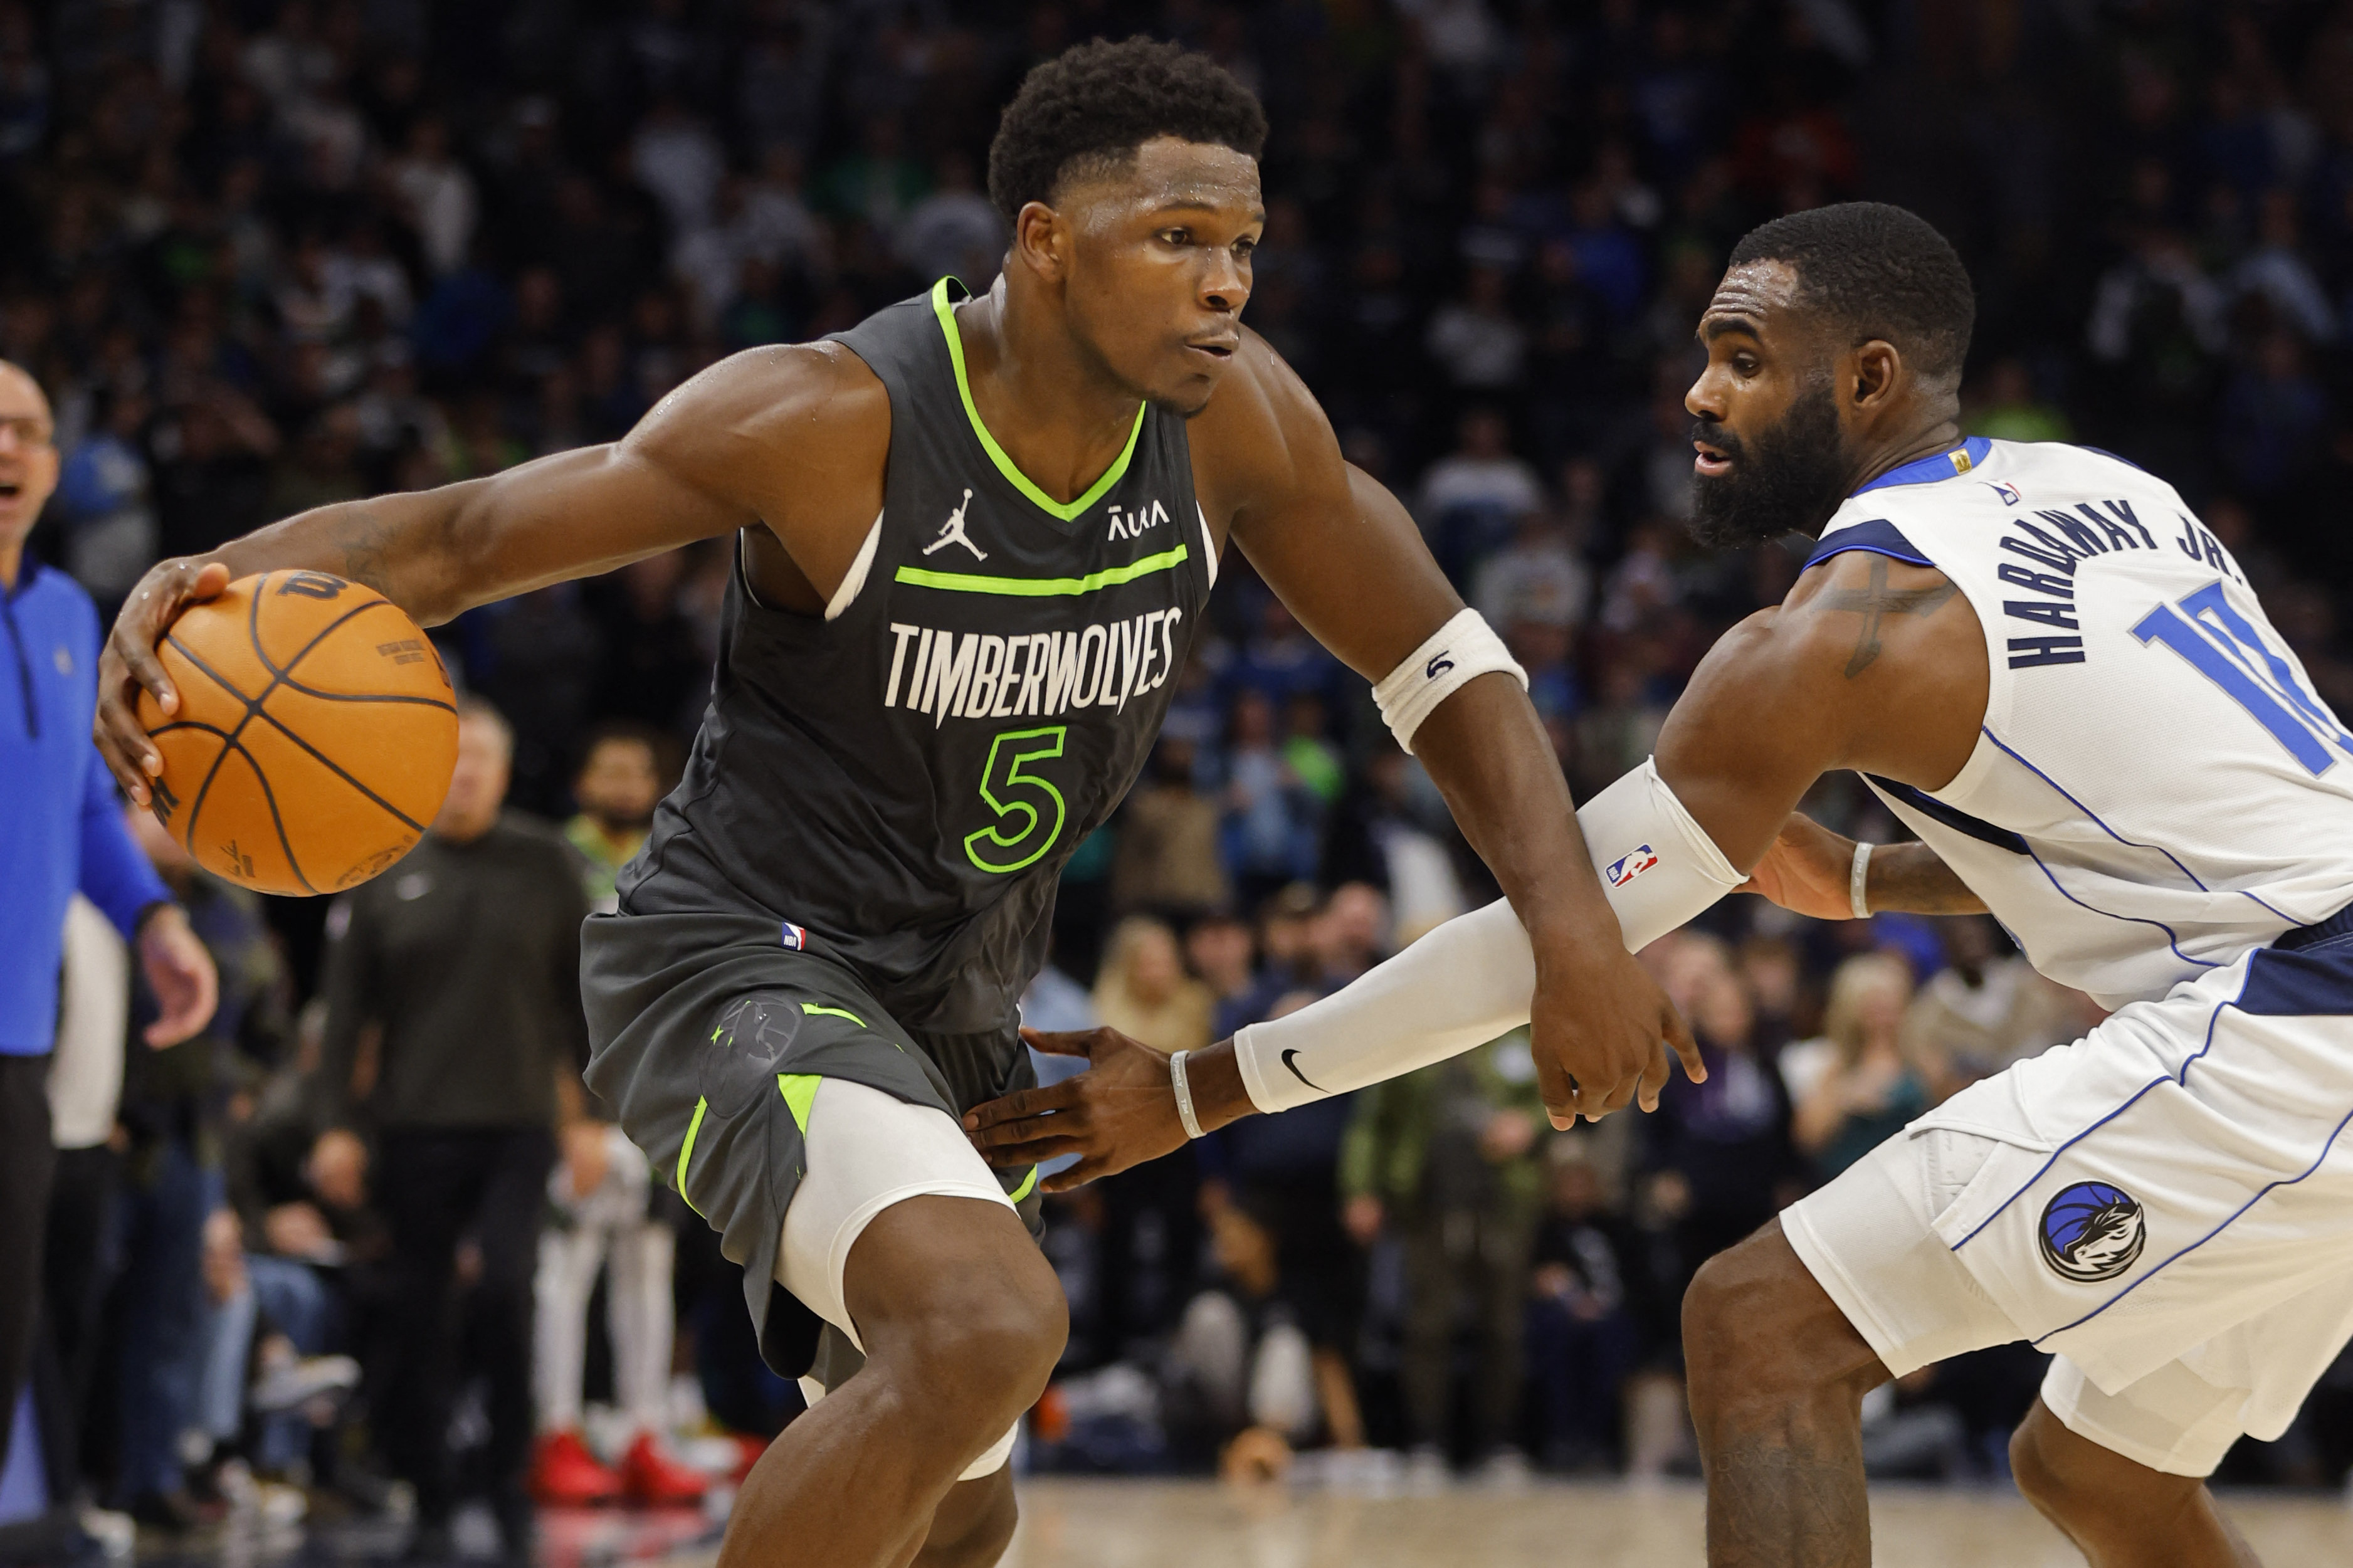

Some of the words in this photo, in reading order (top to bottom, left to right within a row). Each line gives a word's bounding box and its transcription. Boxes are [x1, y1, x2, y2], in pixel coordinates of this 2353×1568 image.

[1998, 500, 2158, 669] HARDAWAY
[2176, 512, 2242, 586] JR.
[885, 607, 1182, 729] TIMBERWOLVES
[964, 726, 1066, 873] 5
[1607, 866, 1620, 881] NBA
[783, 935, 797, 947] NBA
